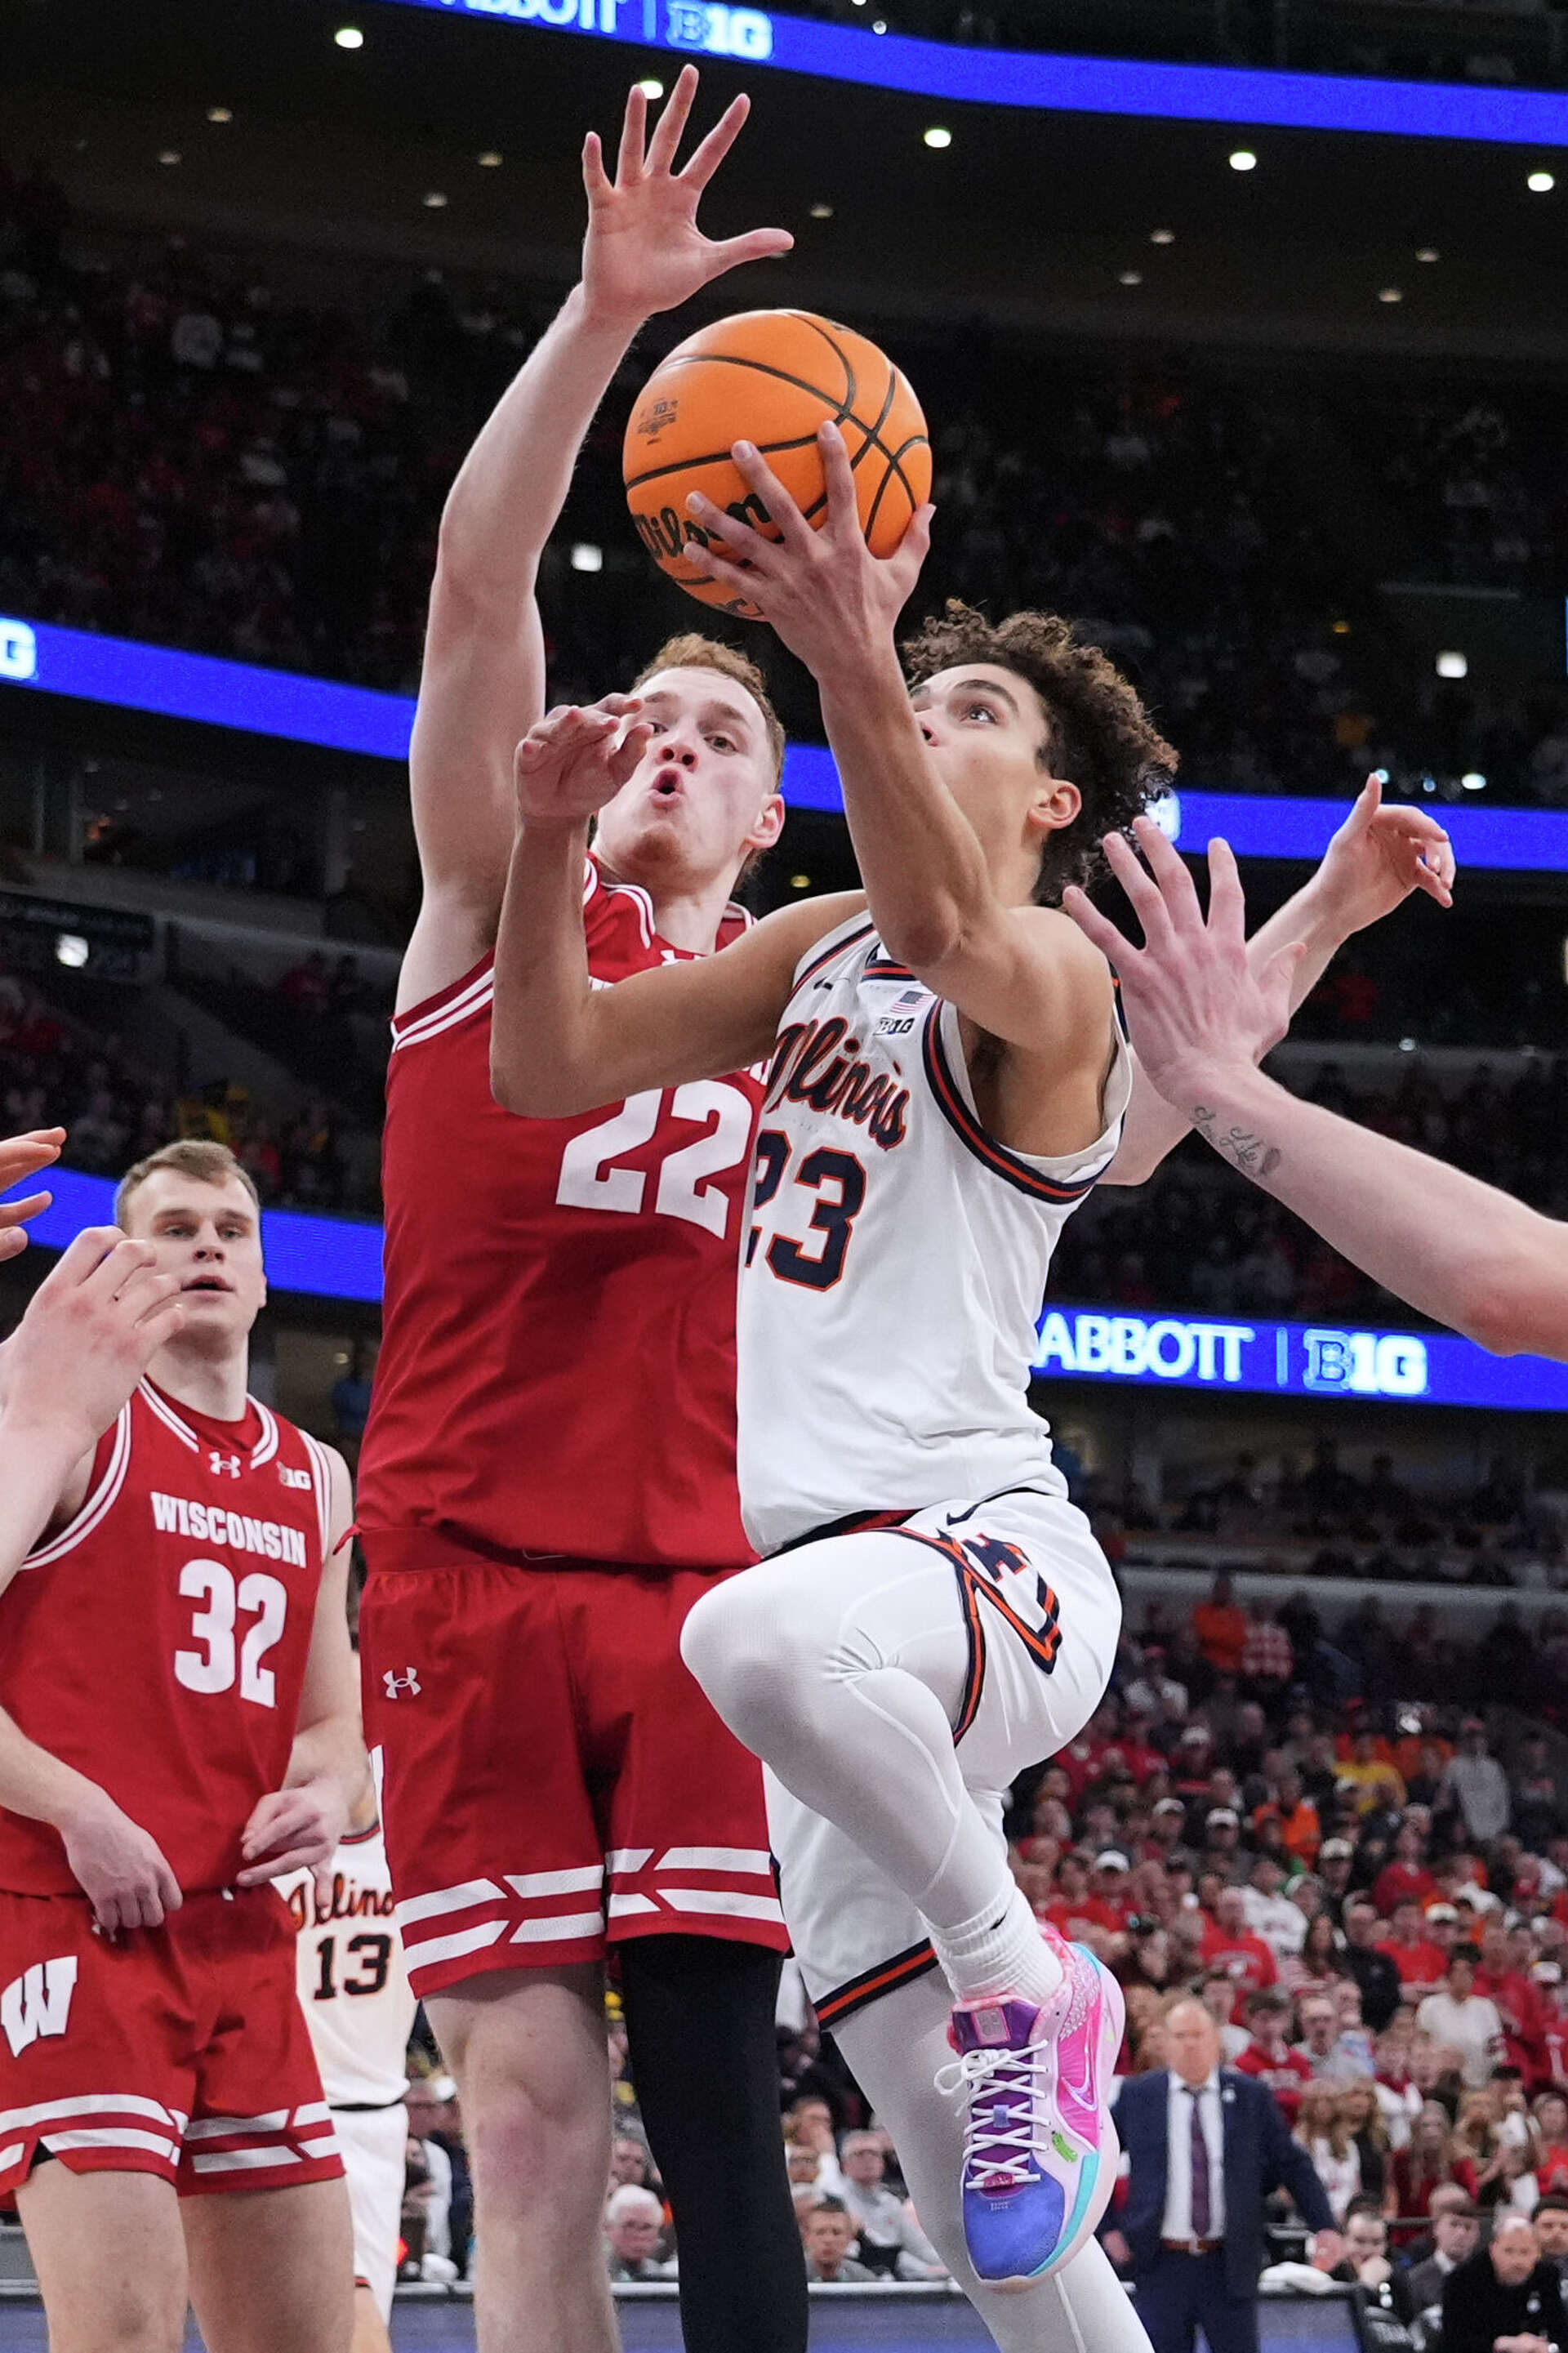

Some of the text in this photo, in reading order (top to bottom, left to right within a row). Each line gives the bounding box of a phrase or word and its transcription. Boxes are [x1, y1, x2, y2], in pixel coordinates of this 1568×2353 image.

[765, 1017, 911, 1151] Ilinois
[556, 1079, 752, 1240] 22
[1033, 1312, 1255, 1381] ABBOTT
[150, 1491, 306, 1569] WISCONSIN
[174, 1558, 287, 1709] 32
[1, 1955, 78, 2057] W
[314, 1934, 393, 2000] 13
